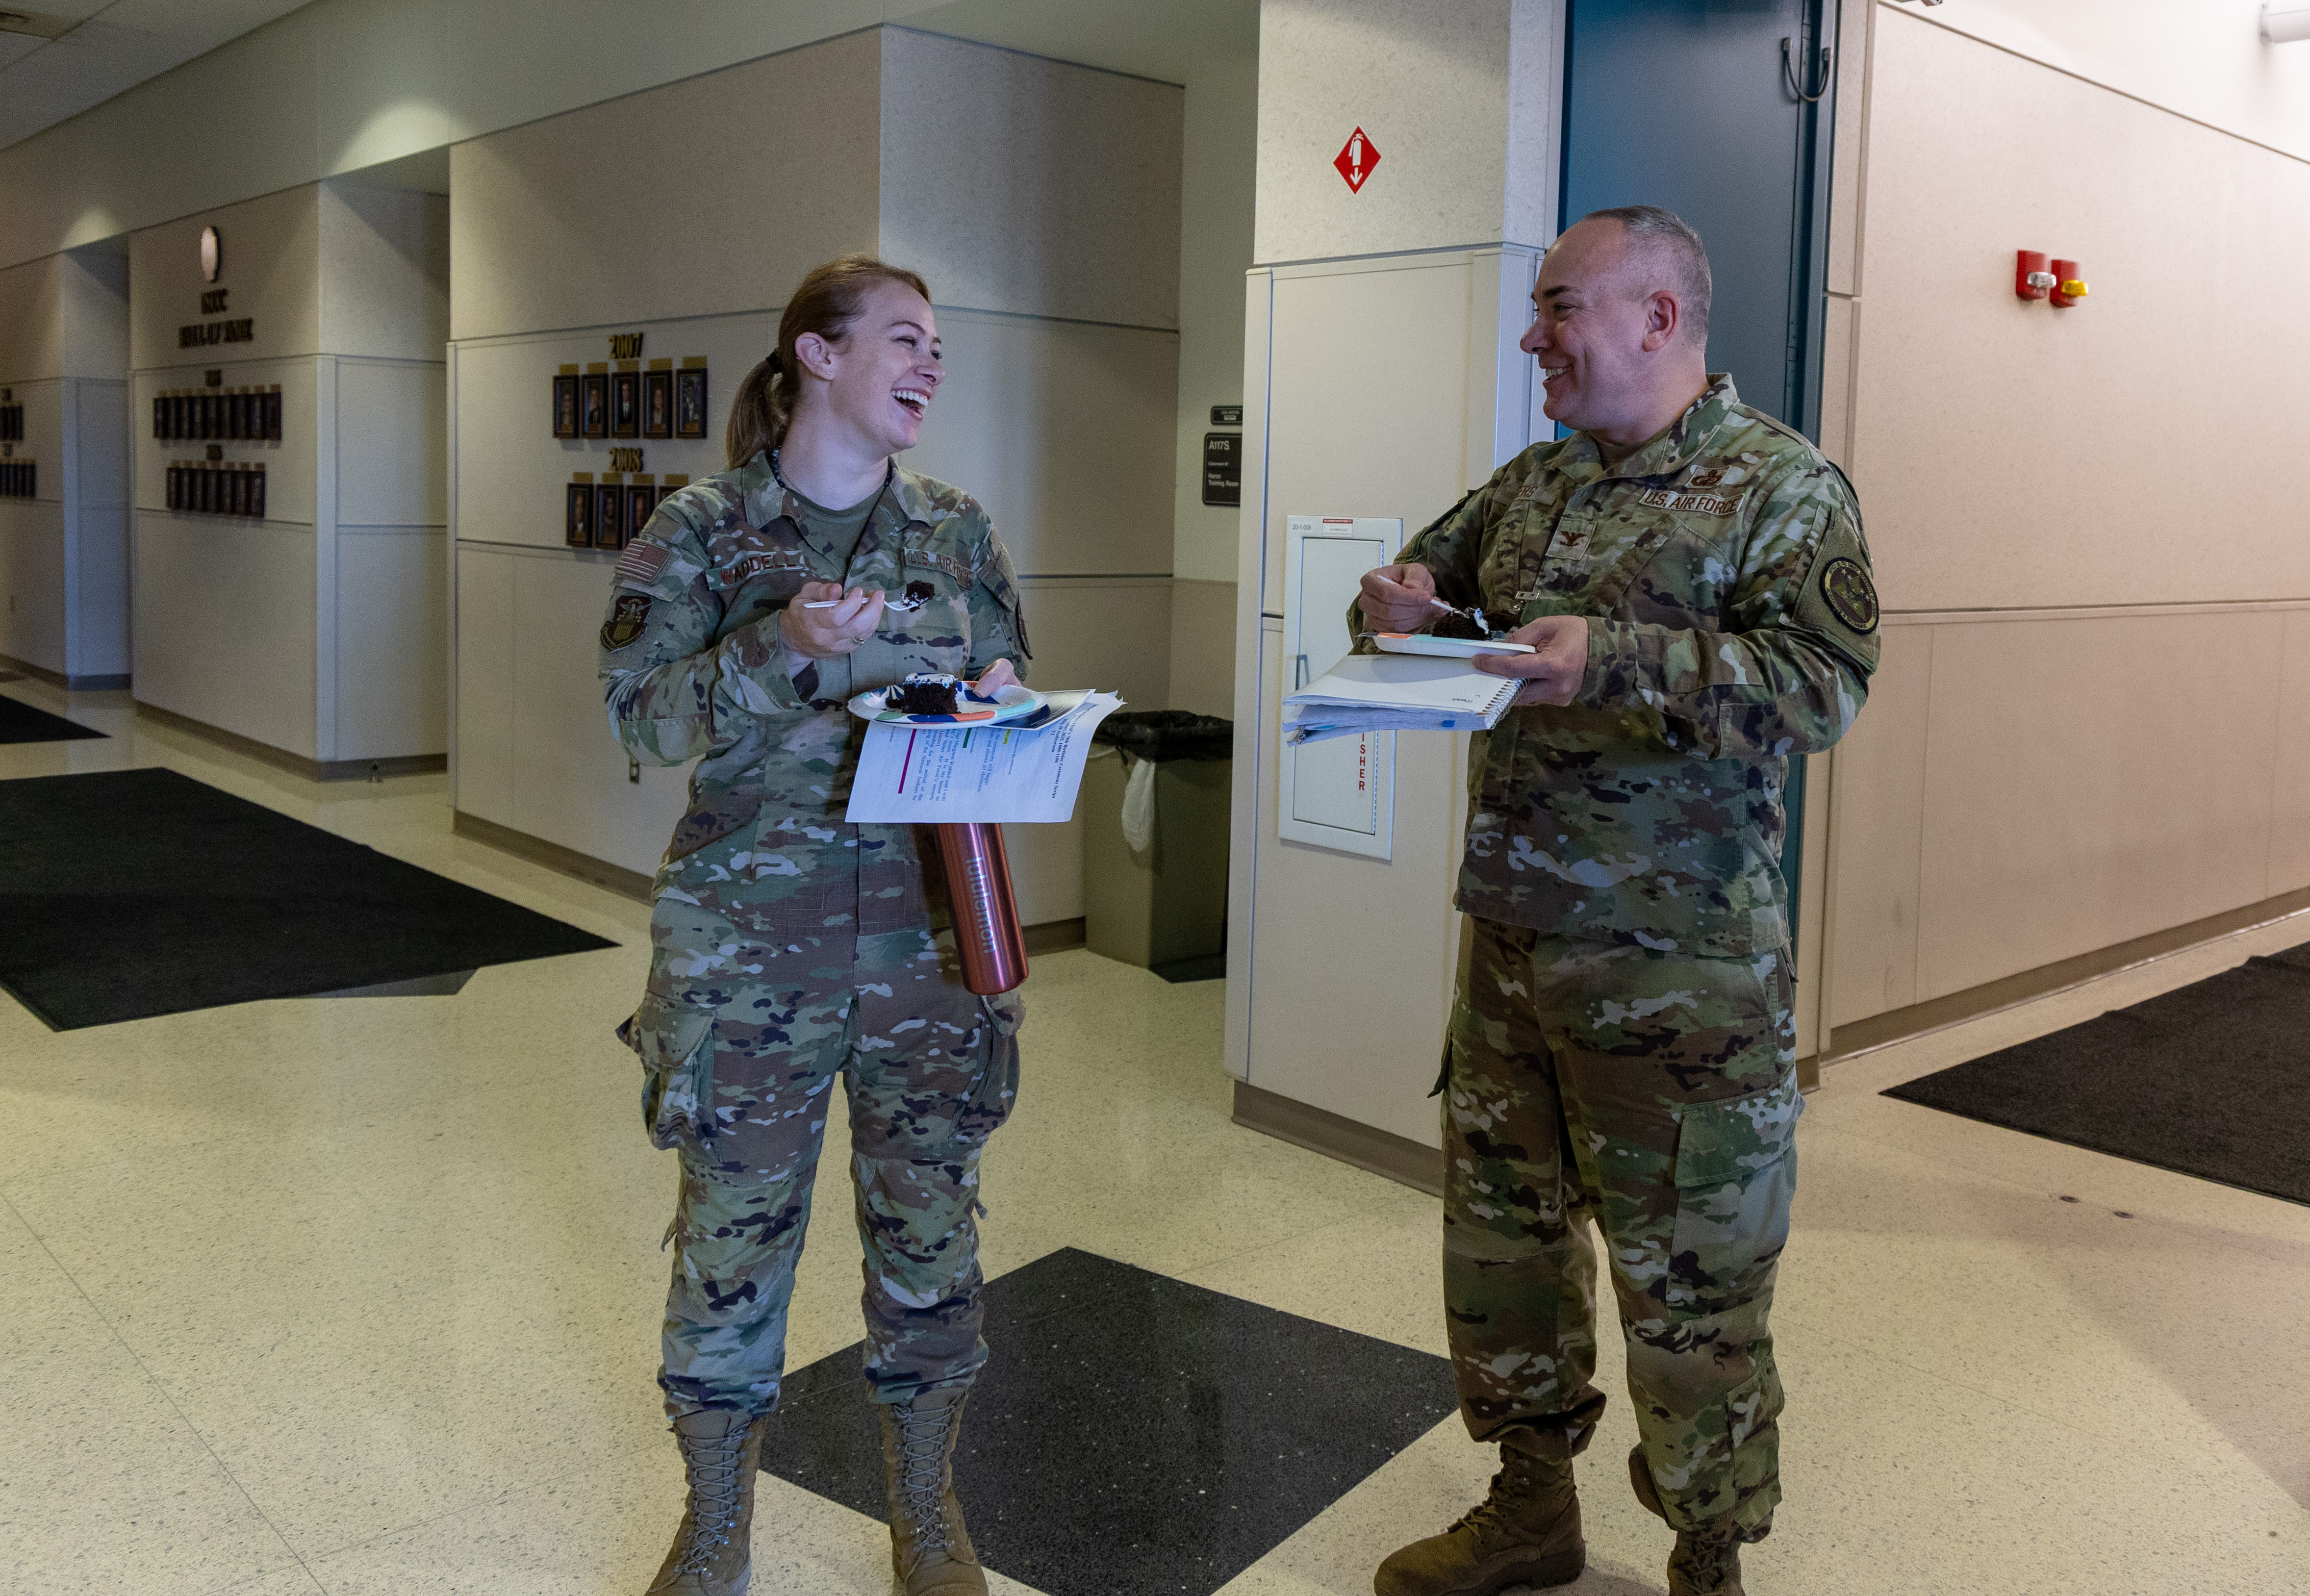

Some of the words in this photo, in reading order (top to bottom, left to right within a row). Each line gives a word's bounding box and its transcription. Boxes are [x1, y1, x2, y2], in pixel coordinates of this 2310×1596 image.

[609, 333, 643, 359] 2007
[1208, 440, 1229, 450] A117S
[609, 447, 643, 472] 2008
[1644, 491, 1667, 507] U.S.
[1669, 496, 1696, 510] AIR
[1695, 497, 1740, 514] FORCE
[718, 554, 797, 584] WADDELL
[909, 551, 933, 566] U.S.
[936, 554, 952, 573] AIR
[951, 740, 960, 759] Margaret
[1052, 730, 1061, 752] Auditorium
[966, 857, 996, 954] lululemon
